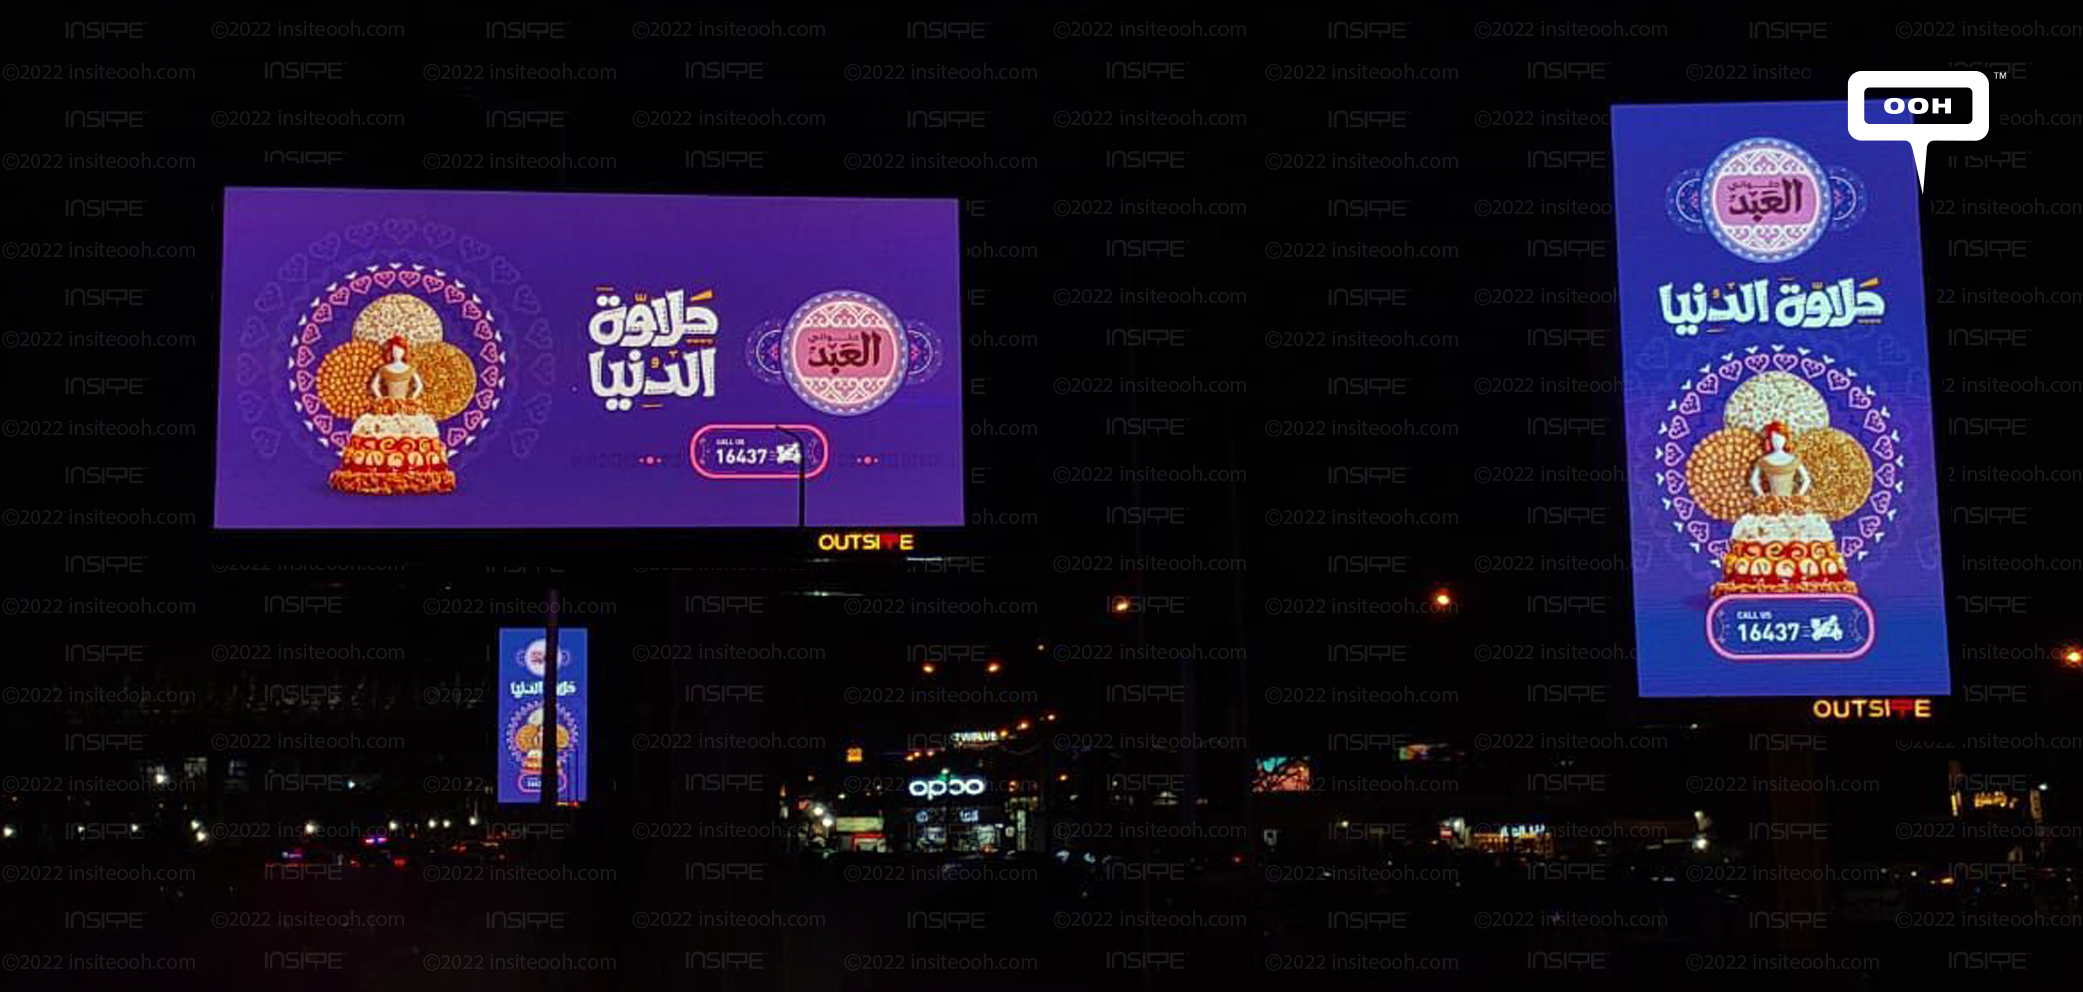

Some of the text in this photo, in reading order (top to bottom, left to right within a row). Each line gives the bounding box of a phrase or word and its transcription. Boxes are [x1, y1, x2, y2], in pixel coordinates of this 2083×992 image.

[716, 449, 767, 465] 16437
[1737, 611, 1758, 620] CALL
[1738, 623, 1800, 641] 16437
